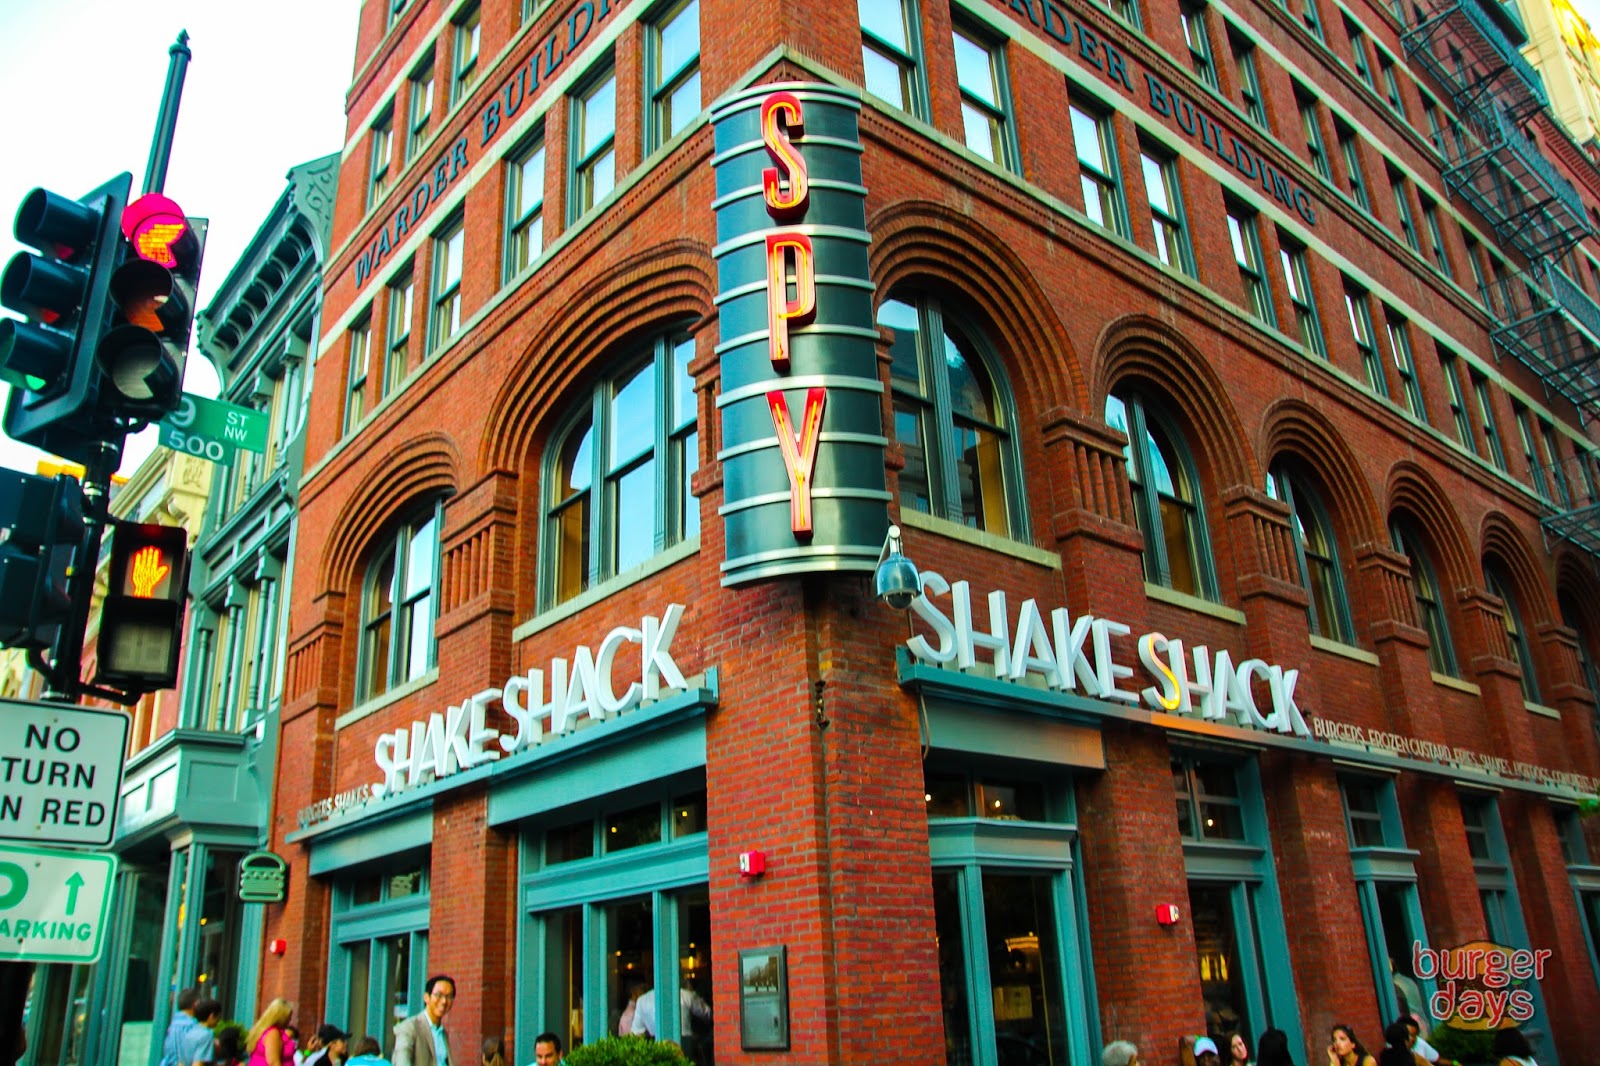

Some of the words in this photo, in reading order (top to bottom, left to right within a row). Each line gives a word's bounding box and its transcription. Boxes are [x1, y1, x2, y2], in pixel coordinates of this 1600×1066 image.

[1143, 71, 1316, 226] BUILDING
[354, 137, 469, 290] WARDER
[760, 91, 827, 539] SPY
[224, 425, 248, 441] NW
[226, 411, 249, 427] ST
[168, 430, 224, 461] 500
[906, 570, 1140, 703] SHAKE
[1138, 632, 1312, 737] SHACK
[371, 688, 502, 798] SHAKE
[499, 603, 689, 752] SHACK
[24, 723, 81, 753] NO
[1, 757, 96, 789] TURN
[40, 799, 105, 827] RED
[0, 918, 92, 942] ARKING
